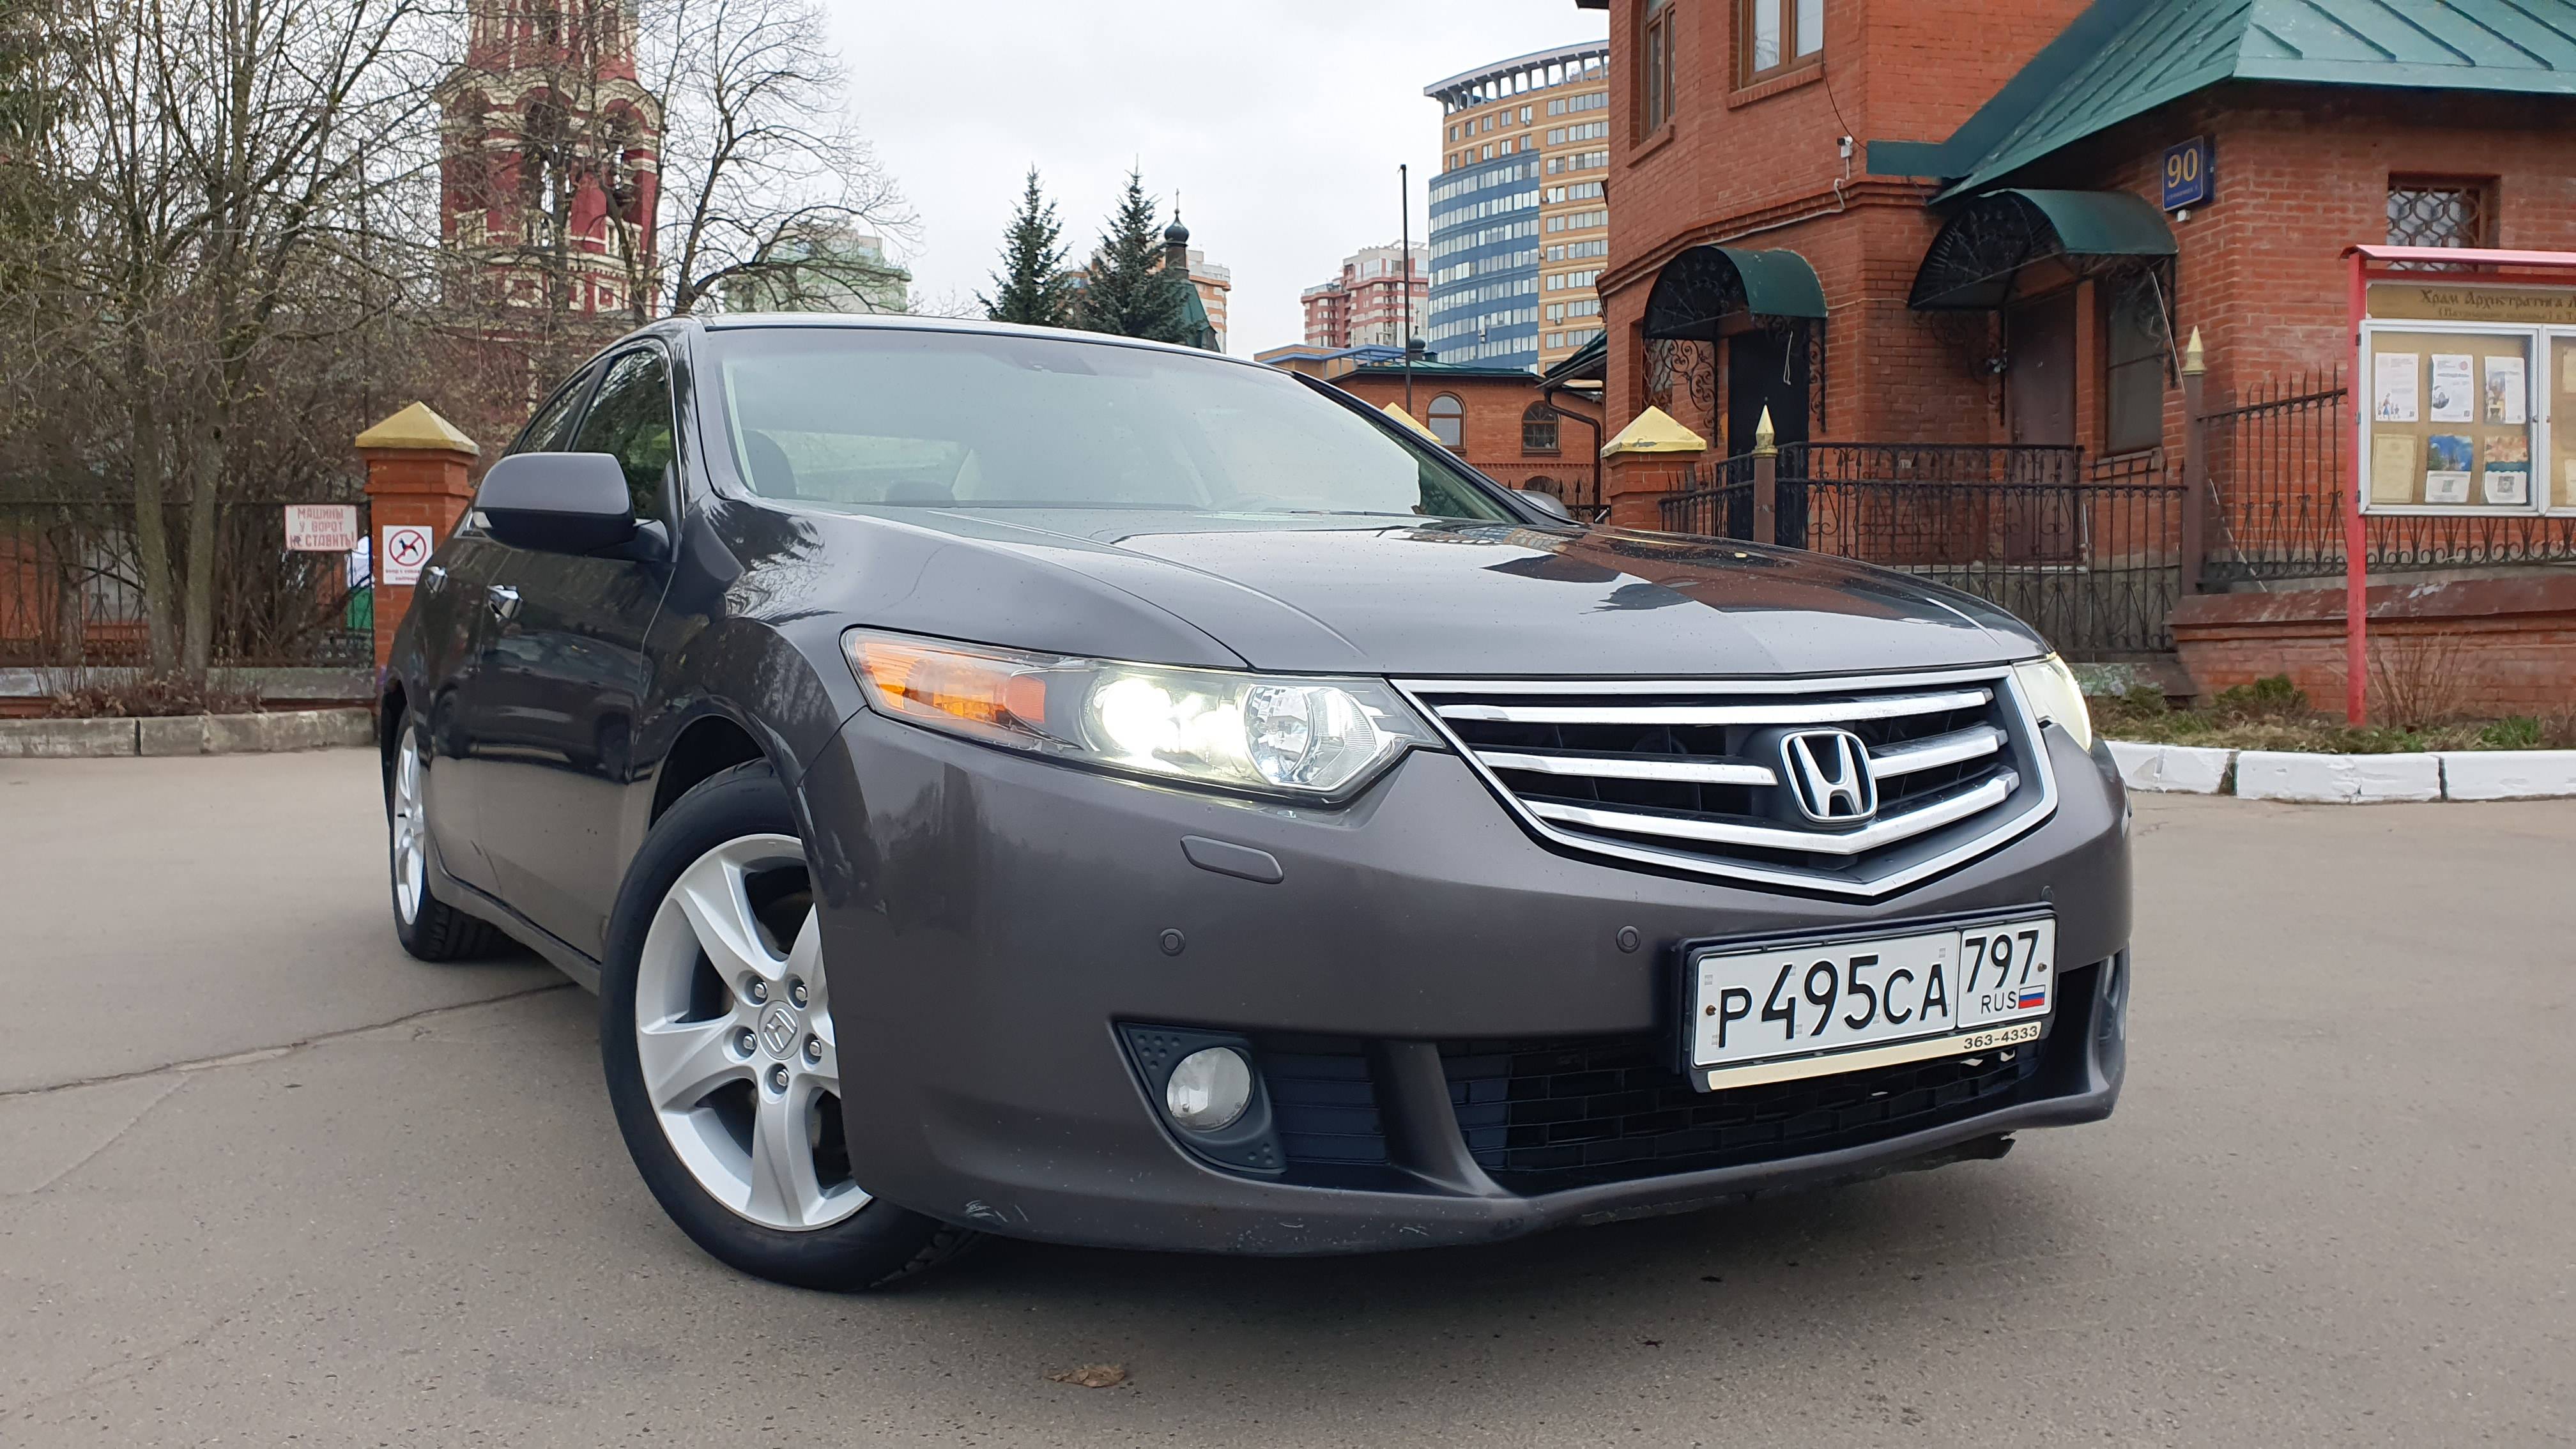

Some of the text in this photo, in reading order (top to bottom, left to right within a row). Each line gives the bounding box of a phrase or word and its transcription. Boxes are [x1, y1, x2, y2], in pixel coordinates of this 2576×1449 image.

[2168, 148, 2198, 188] 90
[297, 508, 344, 520] МАШИНЫ
[299, 521, 343, 533] У ВОРОТ
[1964, 929, 2040, 993] 797
[1717, 954, 1949, 1048] Р495СА
[1981, 993, 2017, 1015] RUS
[1963, 1025, 2039, 1050] 363-4333
